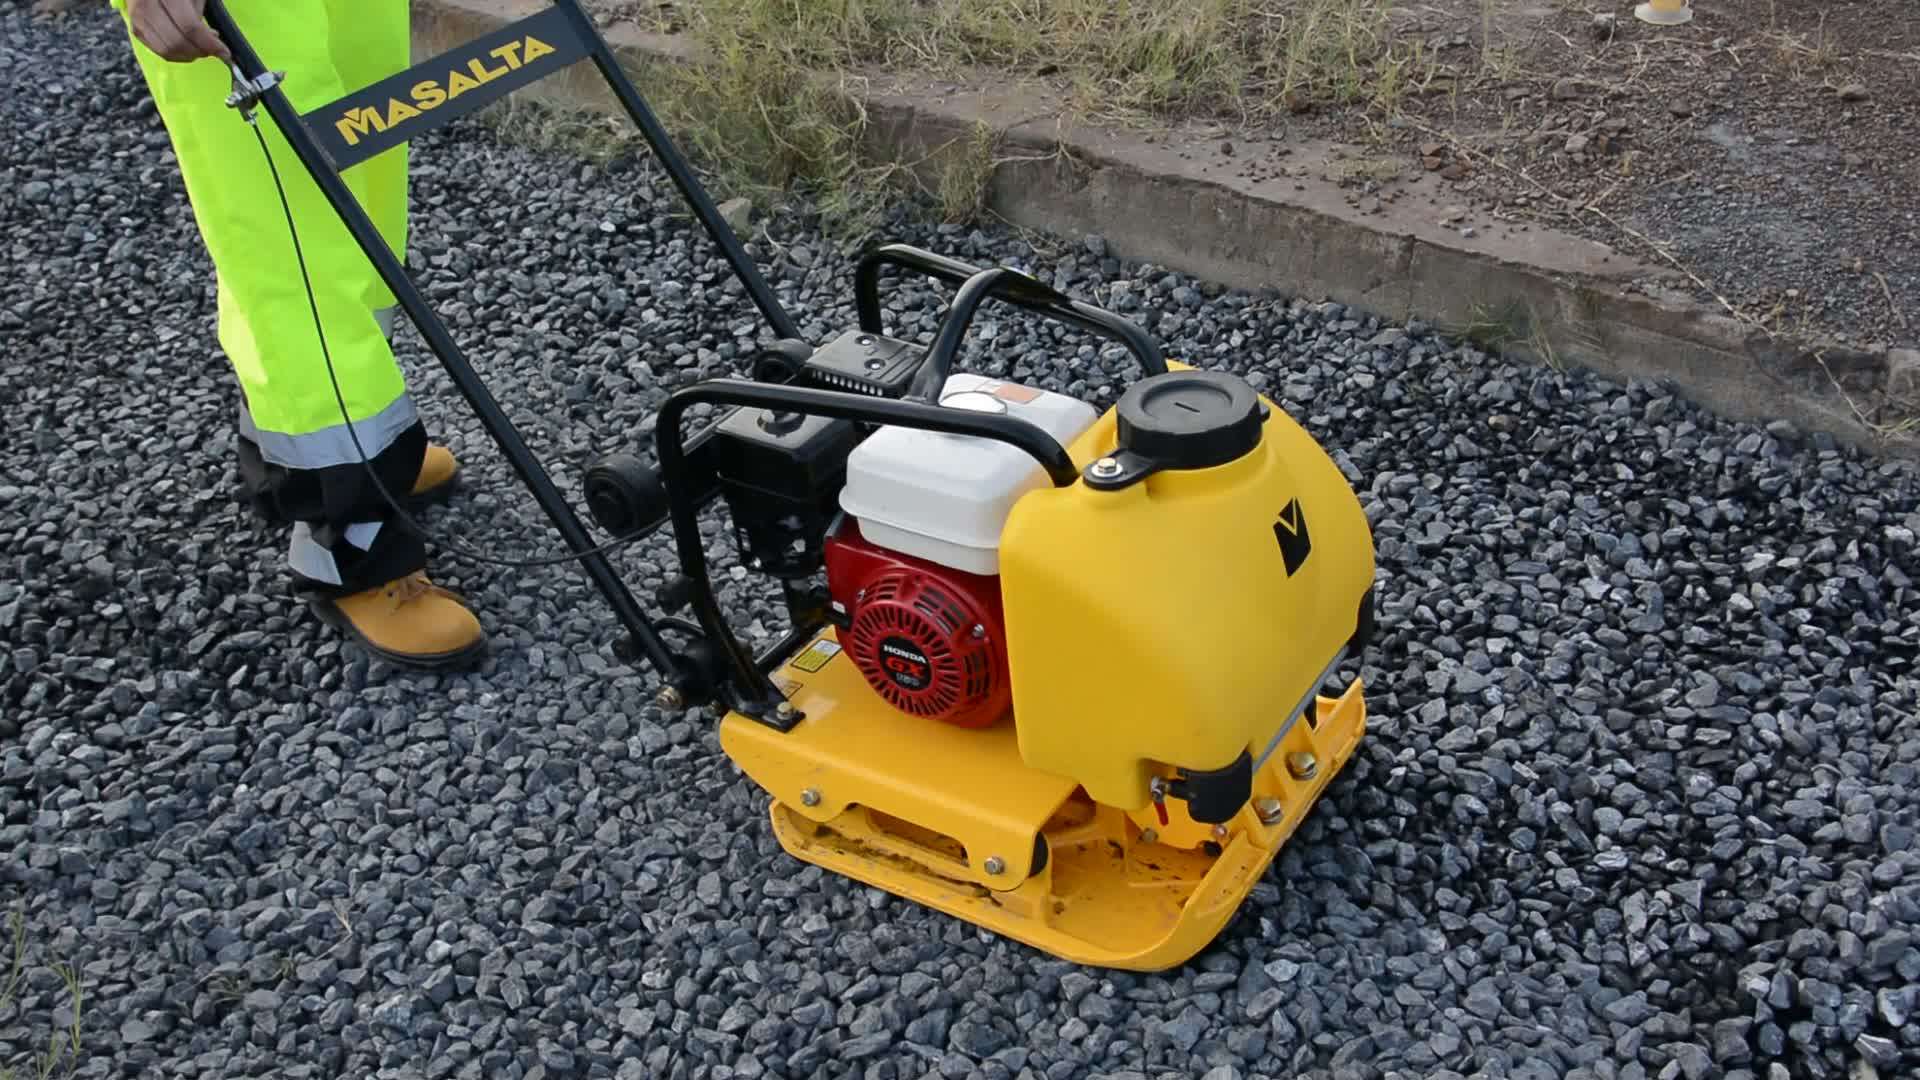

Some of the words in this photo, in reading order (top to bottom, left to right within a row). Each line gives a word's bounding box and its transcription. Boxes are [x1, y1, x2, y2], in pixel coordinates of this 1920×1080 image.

[335, 35, 557, 146] MASALTA
[883, 644, 926, 664] HONDA
[886, 656, 924, 678] GX
